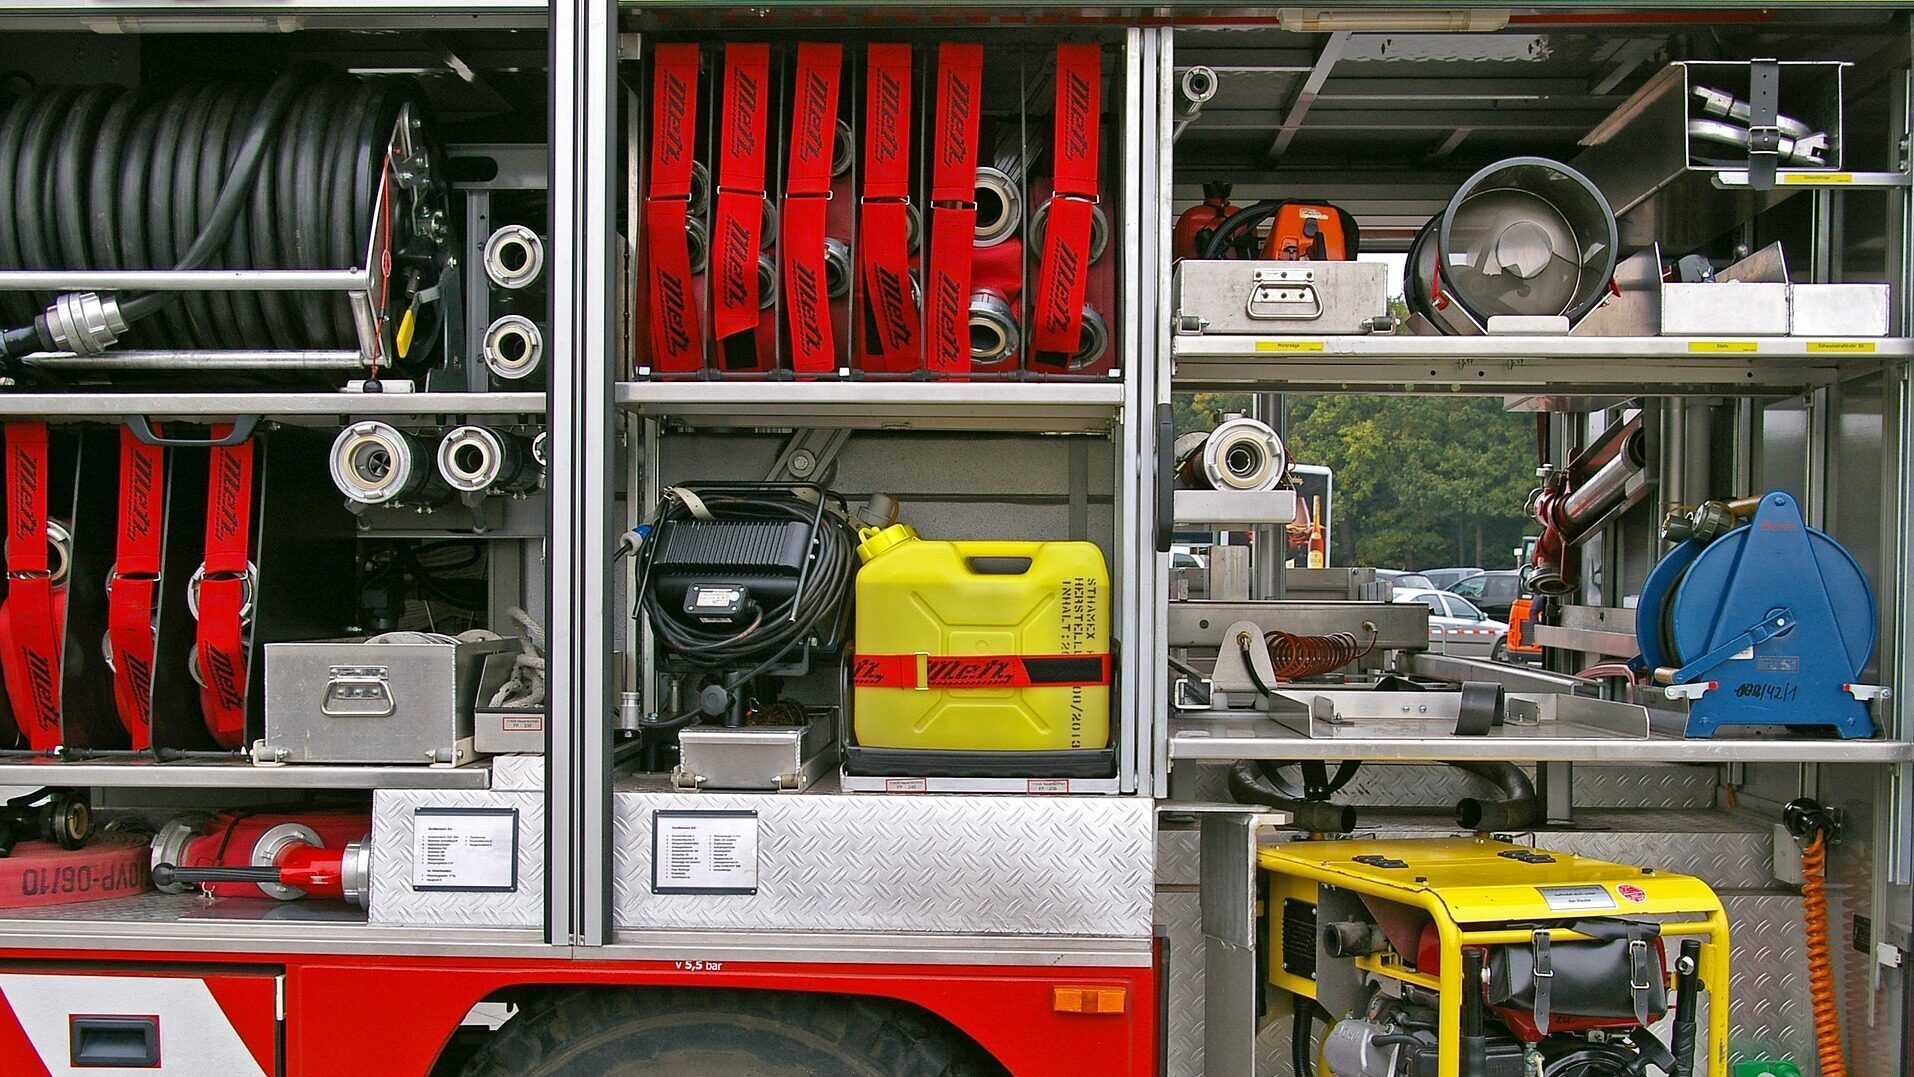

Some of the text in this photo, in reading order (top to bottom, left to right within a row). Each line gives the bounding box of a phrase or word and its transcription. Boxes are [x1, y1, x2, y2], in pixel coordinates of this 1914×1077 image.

[661, 69, 686, 165] Metz
[732, 66, 758, 159] Metz
[800, 67, 828, 163] Metz
[874, 67, 900, 165] Metz
[944, 68, 970, 168] Metz
[1066, 68, 1090, 161] Metz
[723, 213, 750, 309] Metz
[792, 258, 823, 356] Metz
[873, 262, 910, 350] Metz
[1046, 236, 1078, 334] Metz
[657, 265, 690, 358] Metz
[937, 270, 960, 367] Metz
[15, 445, 37, 541] Metz
[127, 446, 152, 542] Metz
[214, 447, 241, 542] Metz
[1086, 578, 1096, 640] STHAMEX
[205, 641, 243, 712] Metz
[684, 960, 703, 972] 5,5
[705, 960, 723, 971] bar
